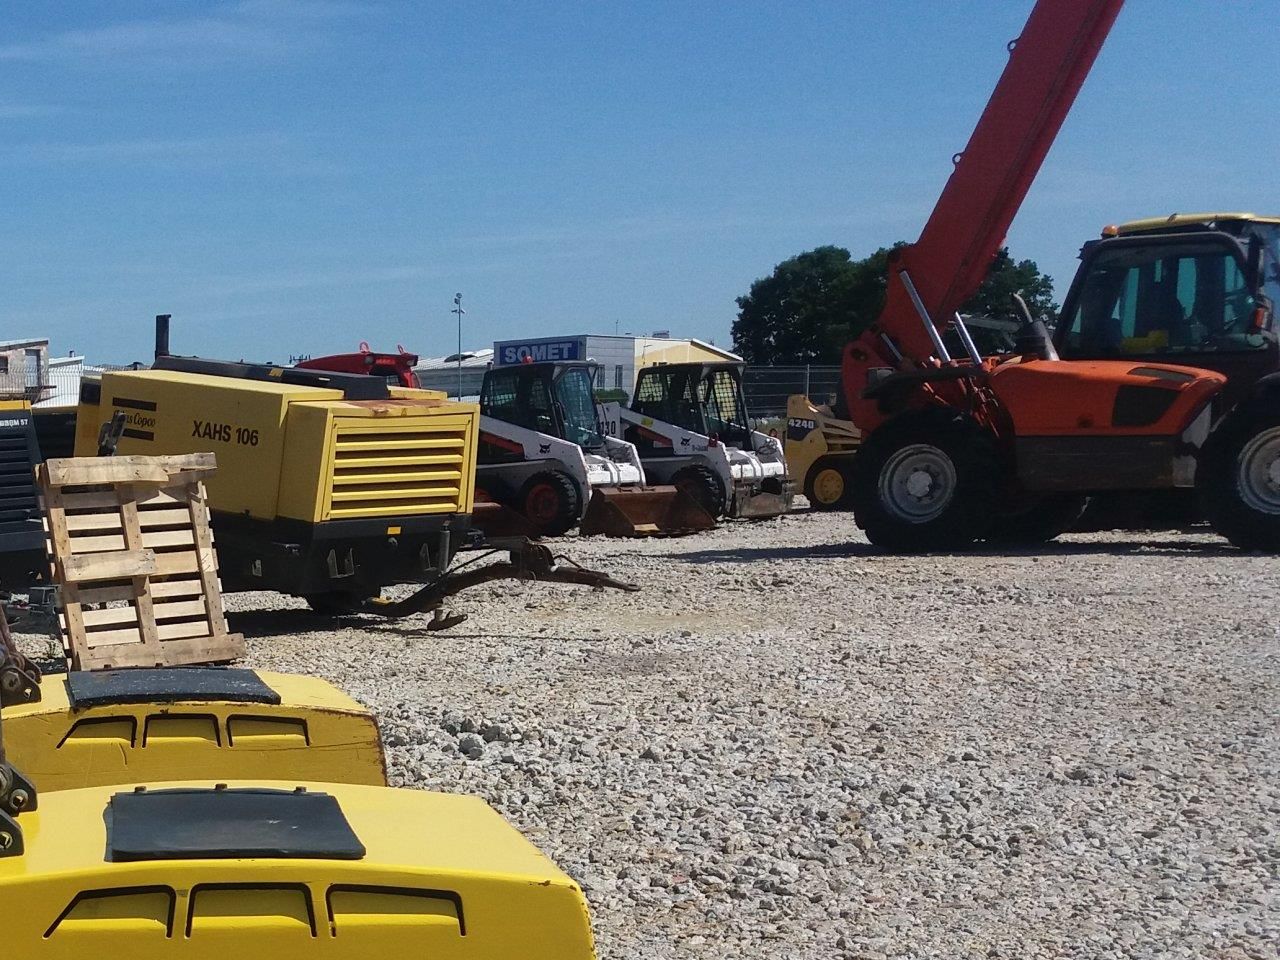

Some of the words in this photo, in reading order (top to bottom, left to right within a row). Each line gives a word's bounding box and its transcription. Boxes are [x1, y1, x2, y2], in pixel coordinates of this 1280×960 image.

[505, 342, 572, 363] SOMET
[133, 412, 156, 429] Copco
[192, 420, 232, 443] XAHS
[235, 427, 260, 447] 106
